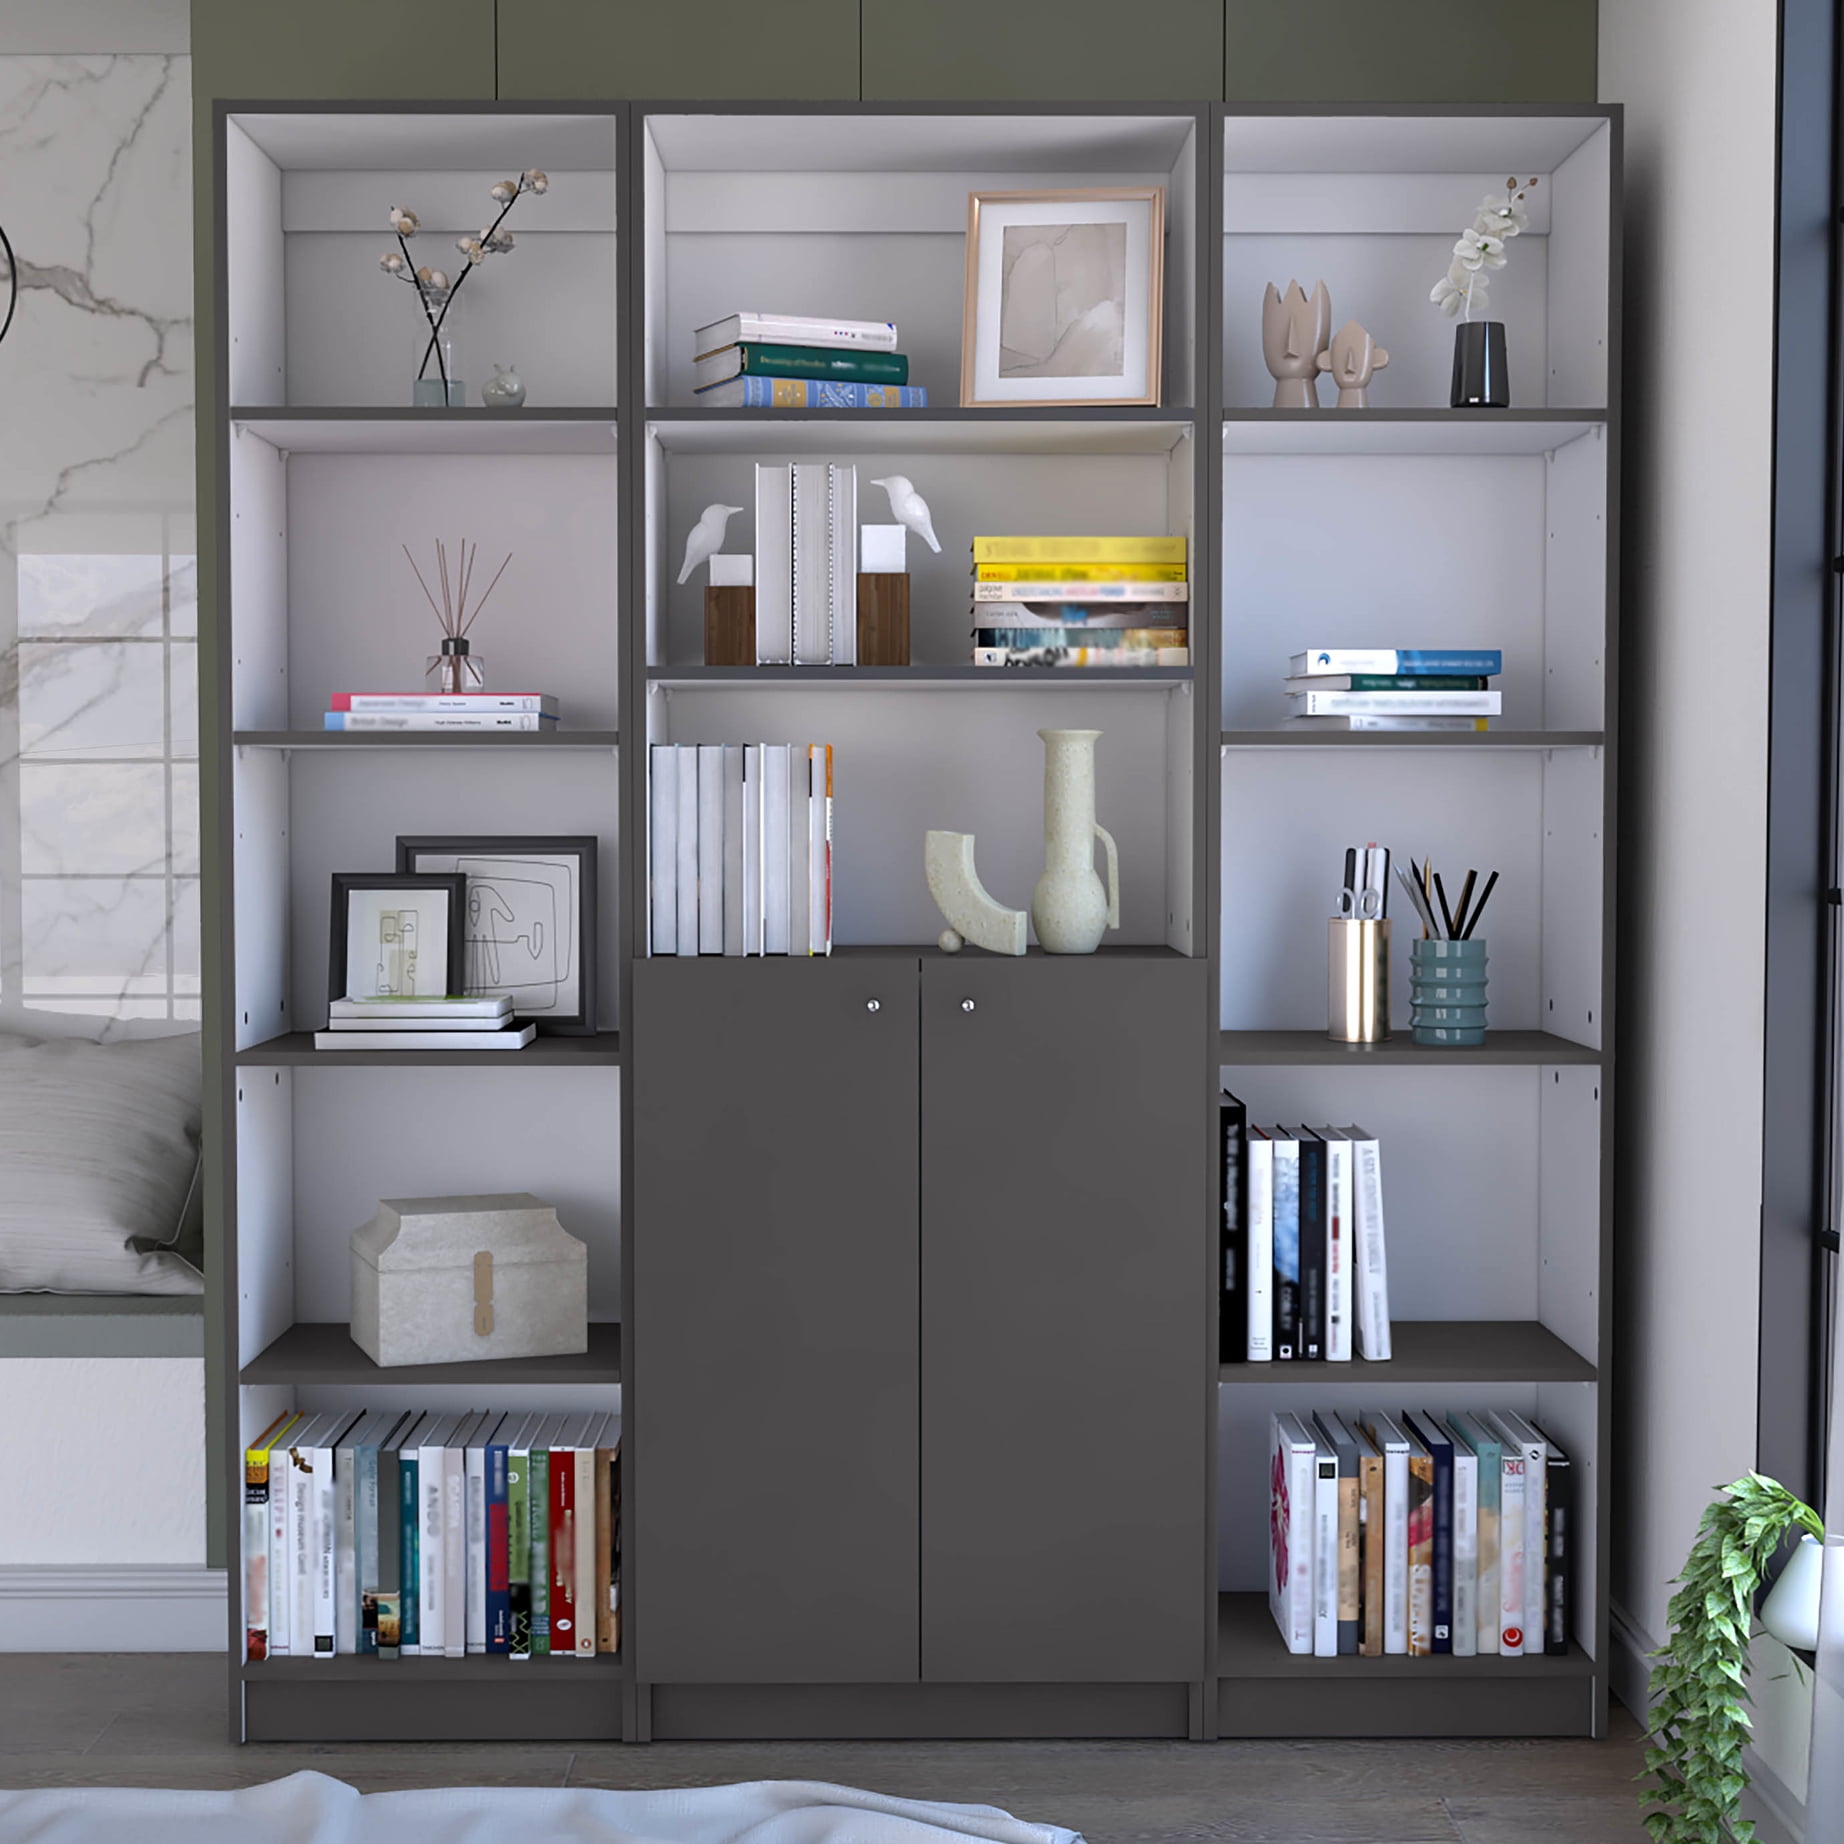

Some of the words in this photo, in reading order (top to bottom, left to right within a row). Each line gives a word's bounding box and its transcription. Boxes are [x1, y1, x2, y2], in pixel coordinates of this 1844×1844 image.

[1504, 1461, 1525, 1476] DK
[295, 1482, 307, 1512] Design
[297, 1514, 306, 1551] museum
